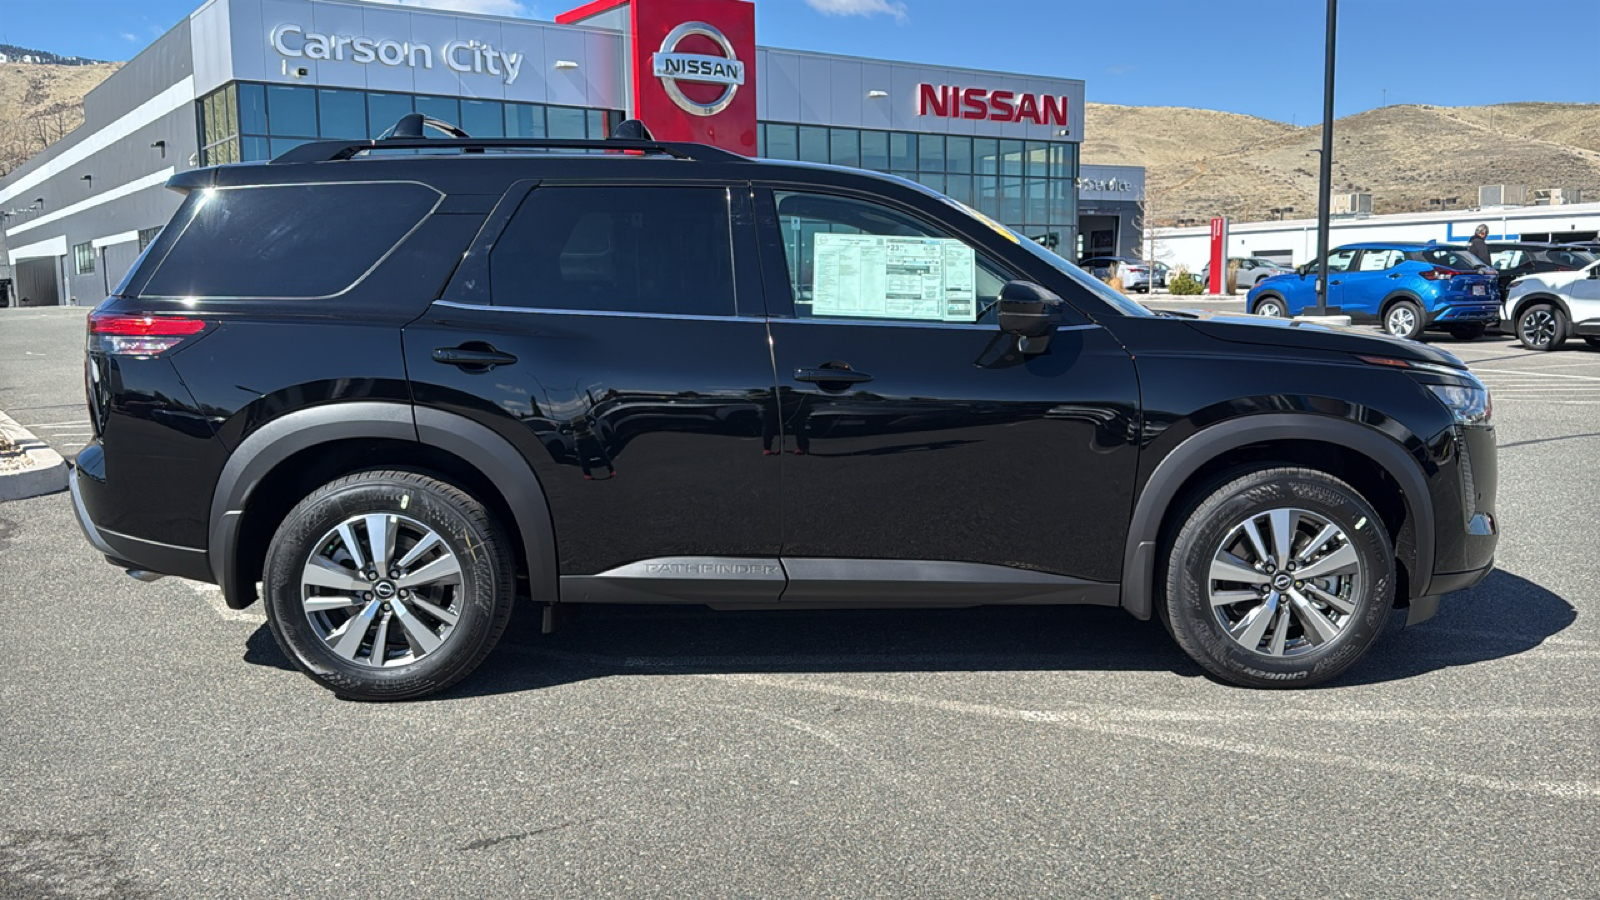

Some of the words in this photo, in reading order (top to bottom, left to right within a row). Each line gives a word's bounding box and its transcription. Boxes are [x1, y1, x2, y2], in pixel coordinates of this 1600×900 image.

[271, 23, 432, 69] Carson
[443, 39, 523, 85] City
[665, 58, 738, 78] NISSAN
[918, 83, 1069, 126] NISSAN
[1085, 179, 1131, 191] Service
[645, 563, 779, 575] PATHFINDER
